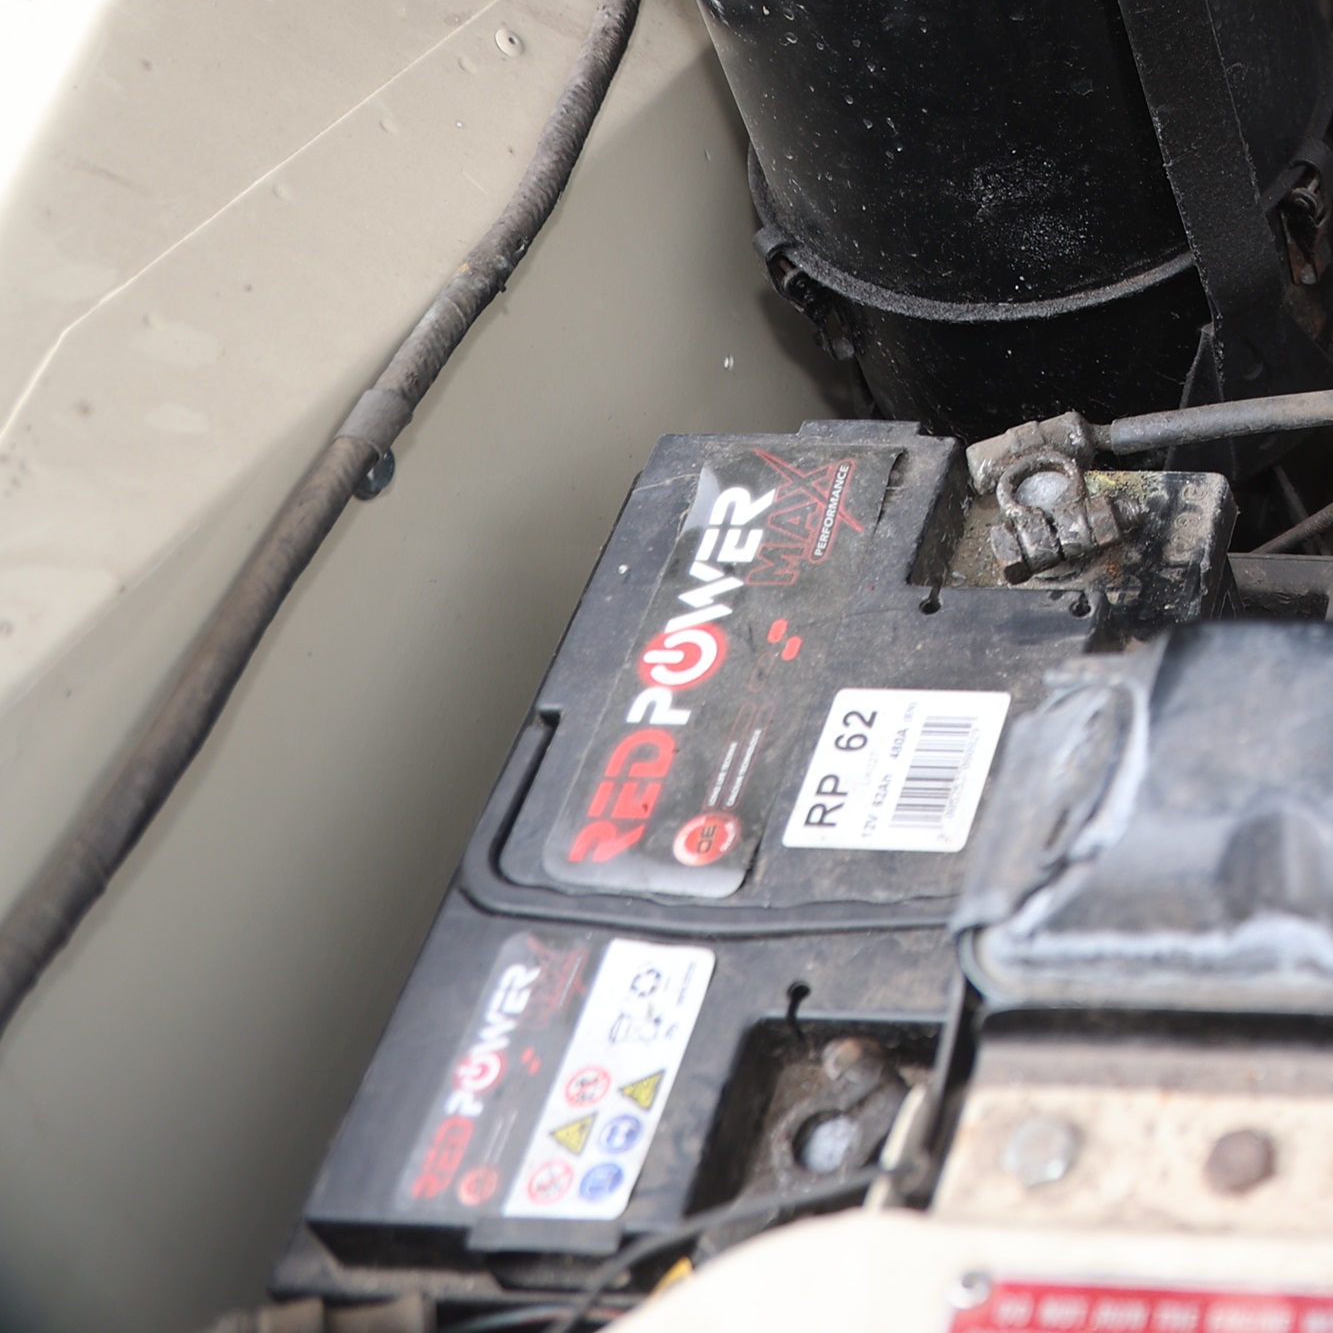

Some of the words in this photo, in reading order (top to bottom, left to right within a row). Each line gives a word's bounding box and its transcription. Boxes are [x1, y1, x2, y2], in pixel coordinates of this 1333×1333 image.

[745, 447, 863, 586] MAX
[813, 463, 849, 558] PERFORMANCE
[804, 773, 848, 828] RP
[834, 710, 878, 753] 62
